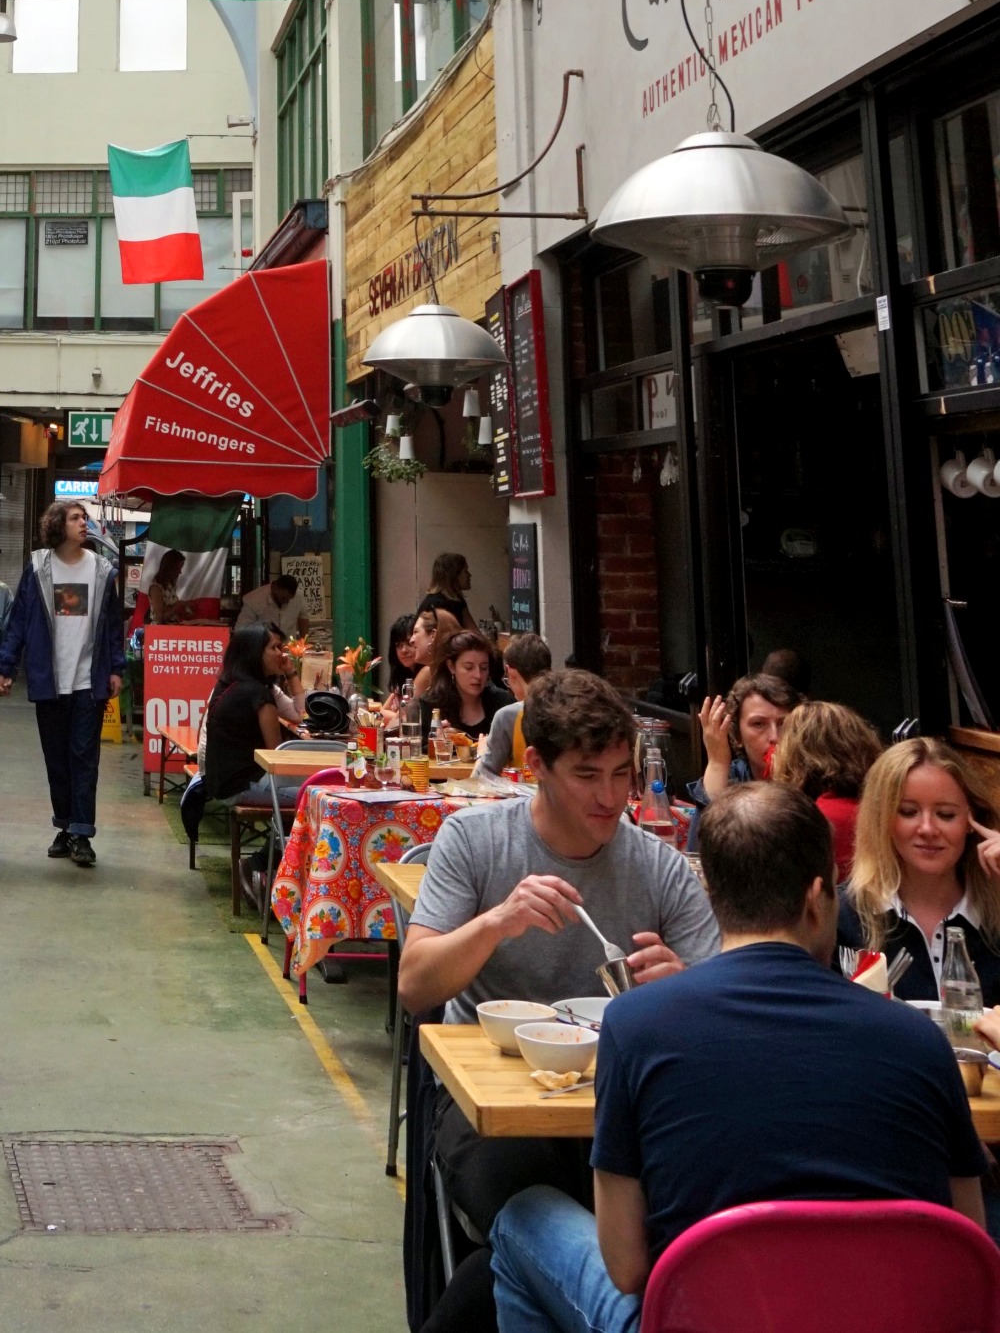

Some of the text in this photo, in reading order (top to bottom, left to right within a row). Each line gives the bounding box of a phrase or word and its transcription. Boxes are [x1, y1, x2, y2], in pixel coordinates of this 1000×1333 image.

[642, 46, 707, 119] AUTHENTIC
[368, 261, 397, 318] SEVEN
[397, 252, 412, 302] AT
[165, 351, 256, 418] Jeffries
[144, 415, 256, 454] Fishmongers
[56, 480, 98, 493] CARRY
[148, 638, 224, 653] JEFFRIES
[148, 653, 224, 664] FISHMONGERS
[152, 665, 220, 675] 07411 777 647
